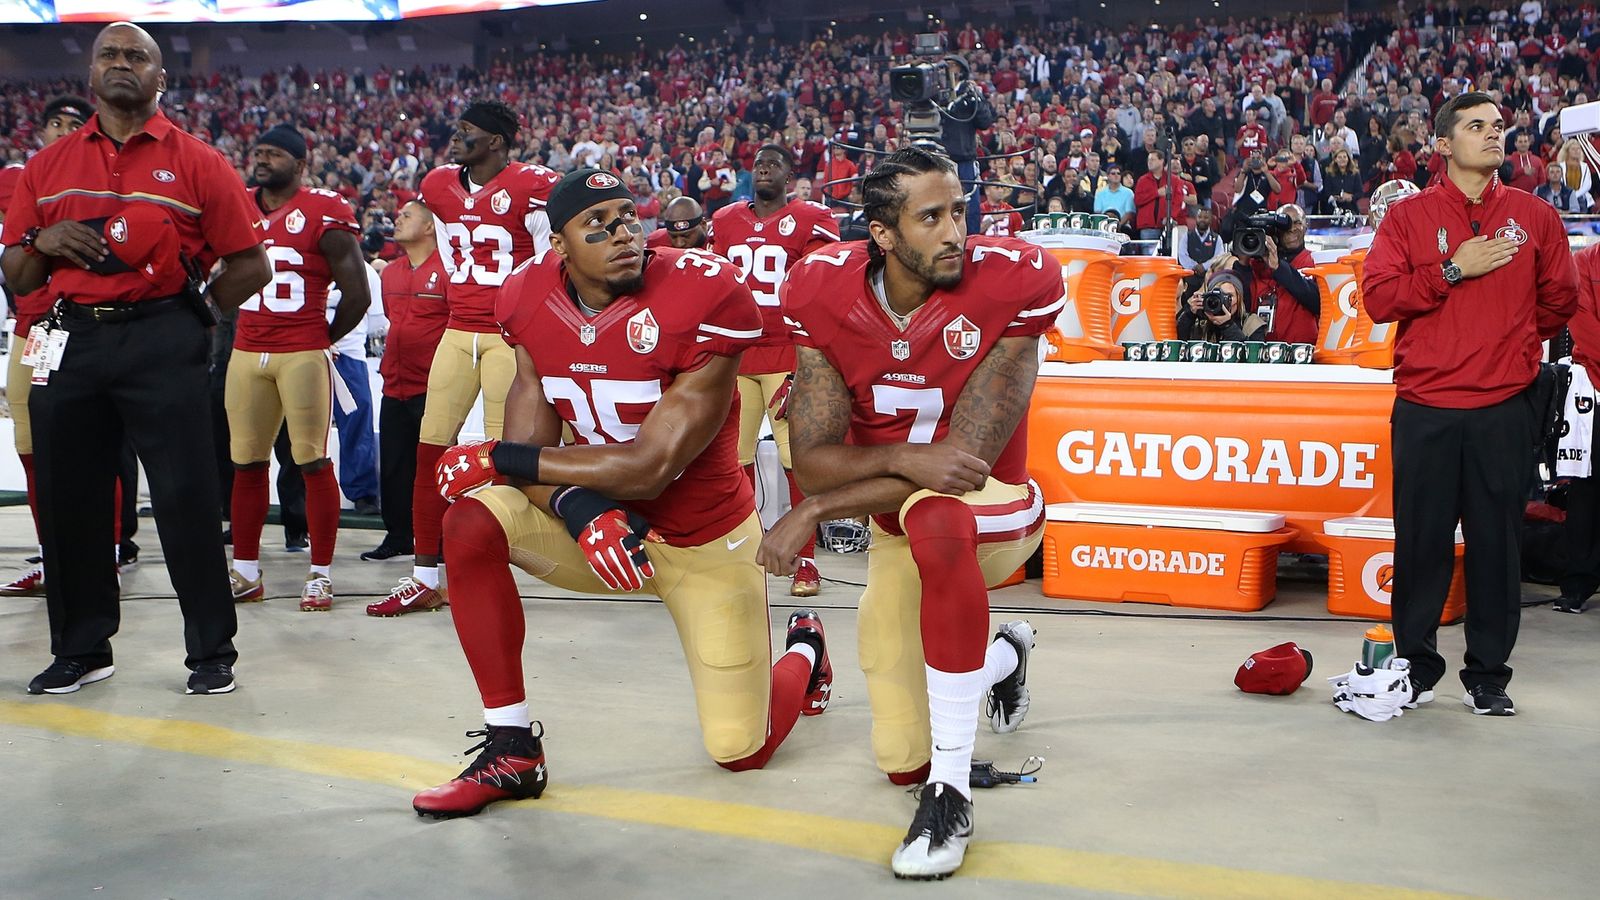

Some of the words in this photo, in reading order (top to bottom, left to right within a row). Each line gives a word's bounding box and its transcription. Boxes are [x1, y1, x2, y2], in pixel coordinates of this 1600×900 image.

[1111, 278, 1141, 315] G
[568, 362, 608, 373] 49ERS
[882, 373, 926, 384] 49ERS
[872, 385, 944, 444] 7
[1056, 430, 1376, 488] GATORADE
[1071, 545, 1225, 577] GATORADE
